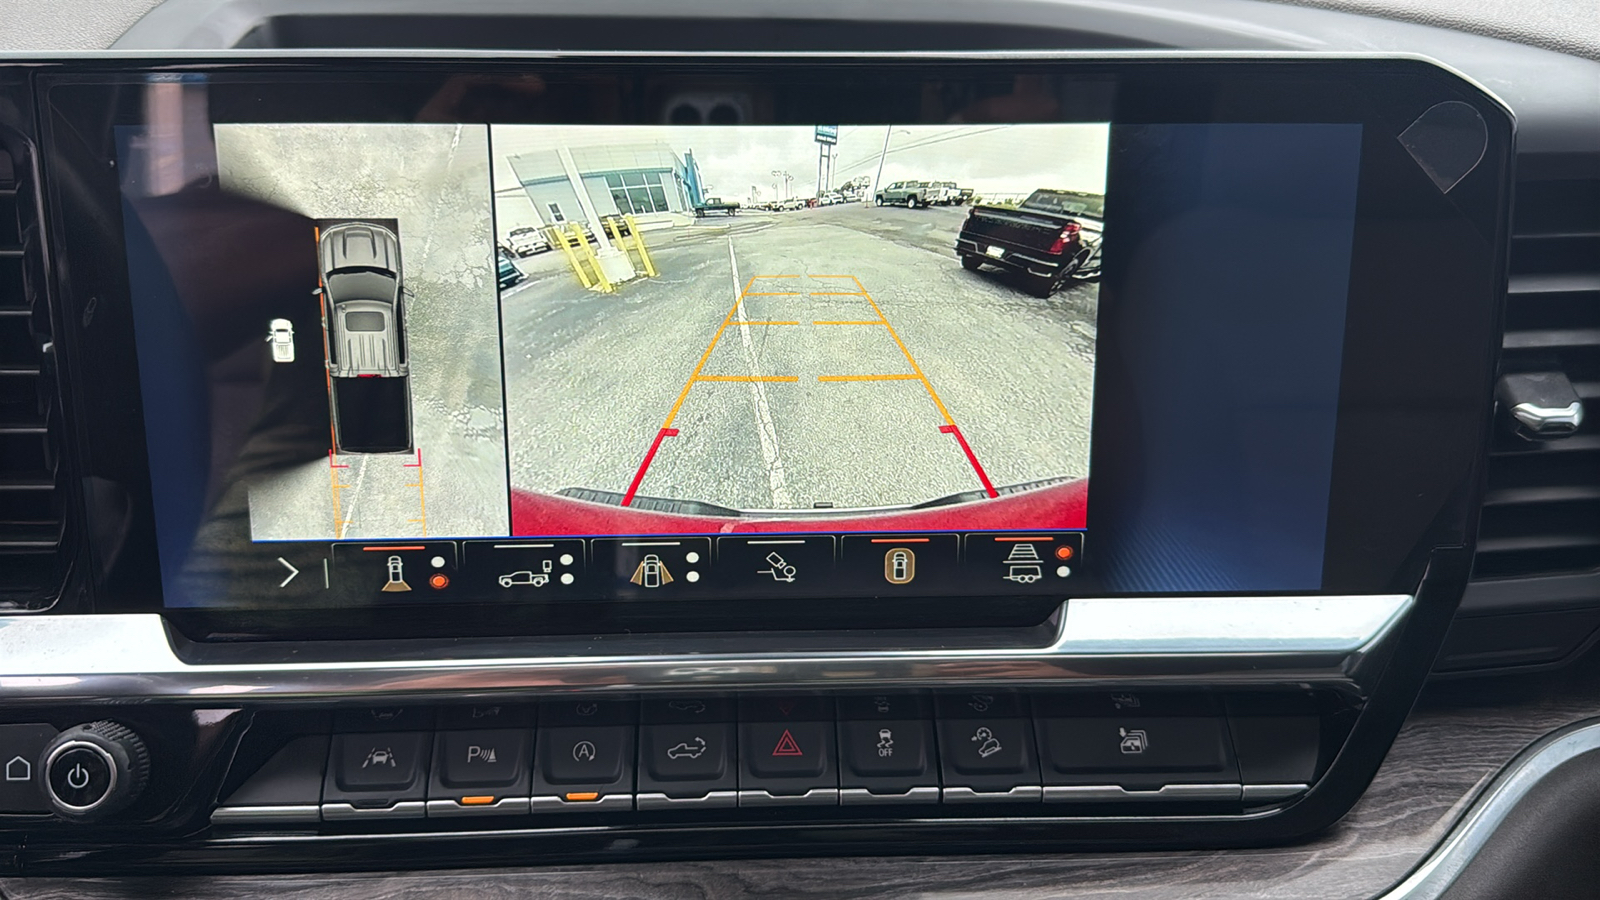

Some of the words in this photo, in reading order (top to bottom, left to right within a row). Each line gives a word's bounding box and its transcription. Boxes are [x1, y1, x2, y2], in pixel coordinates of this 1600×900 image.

[467, 745, 481, 763] P
[578, 744, 589, 757] A
[878, 748, 893, 757] OFF
